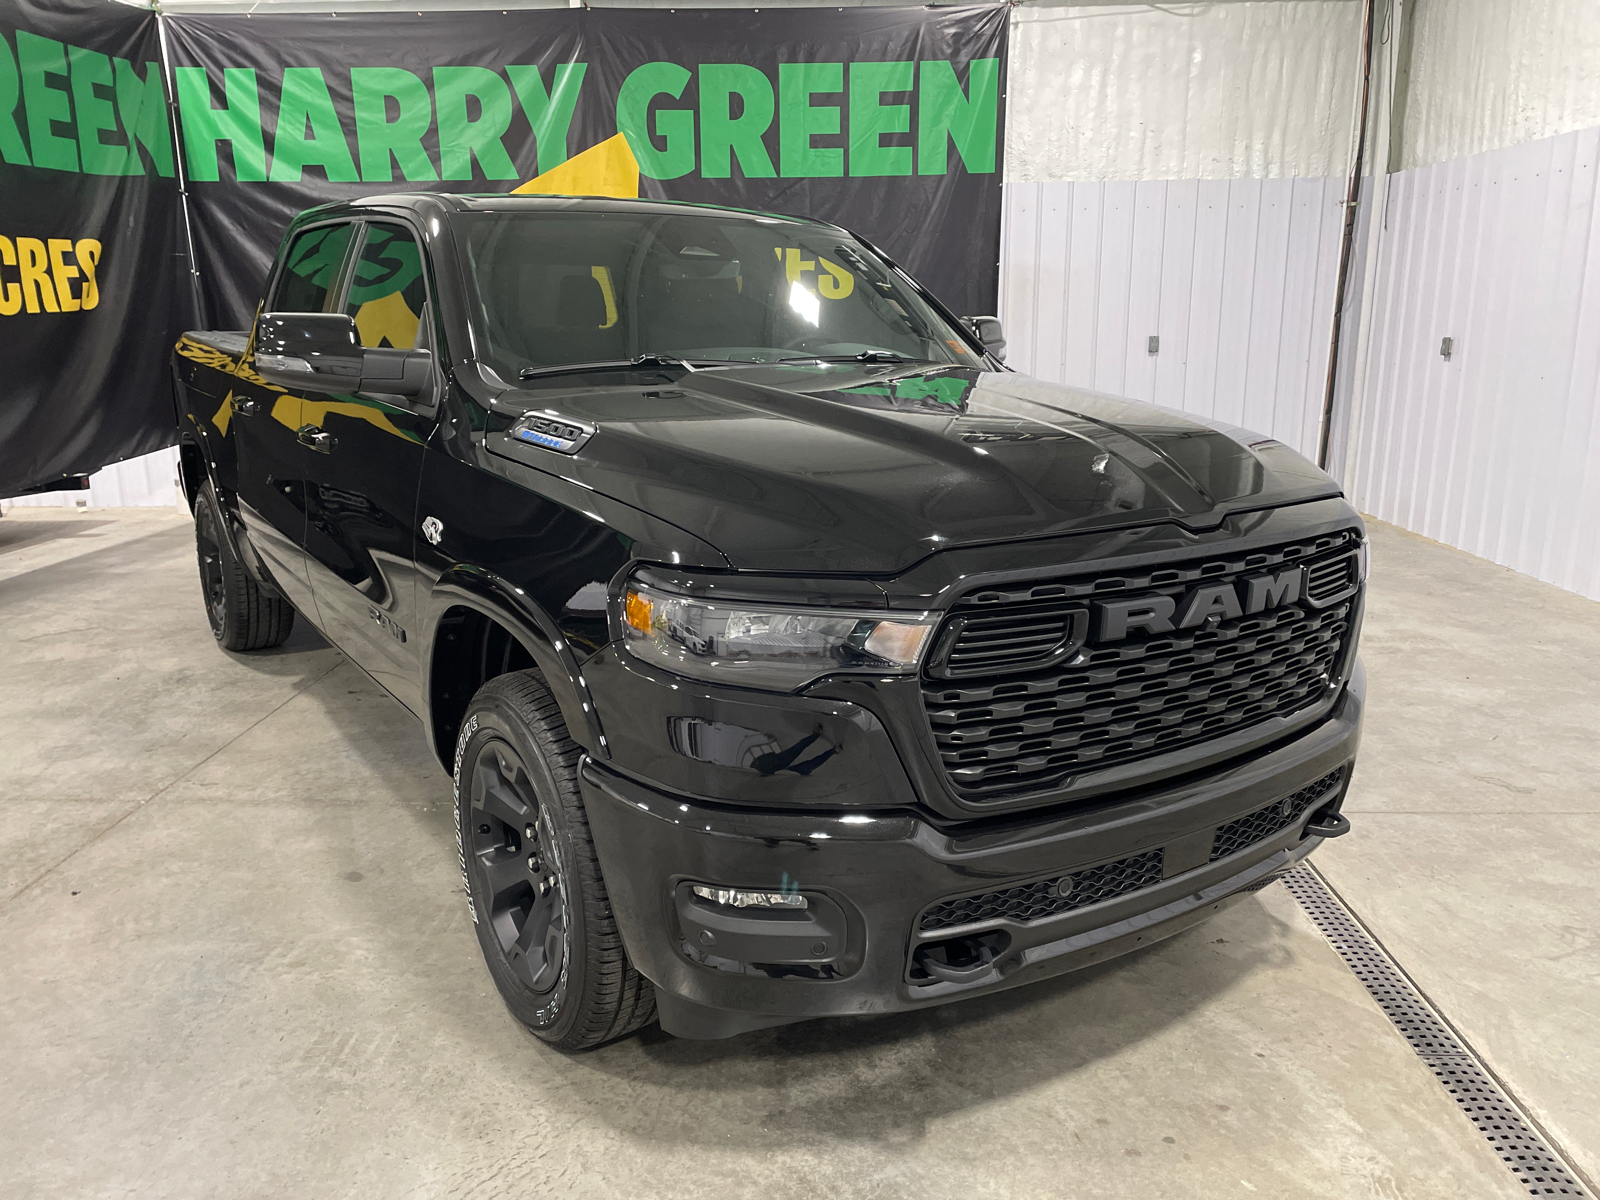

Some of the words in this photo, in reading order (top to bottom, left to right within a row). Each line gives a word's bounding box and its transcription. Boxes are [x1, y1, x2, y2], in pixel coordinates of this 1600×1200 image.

[175, 62, 588, 183] HARRY
[616, 57, 1000, 180] GREEN
[527, 417, 583, 441] 1500
[1094, 565, 1301, 642] RAM
